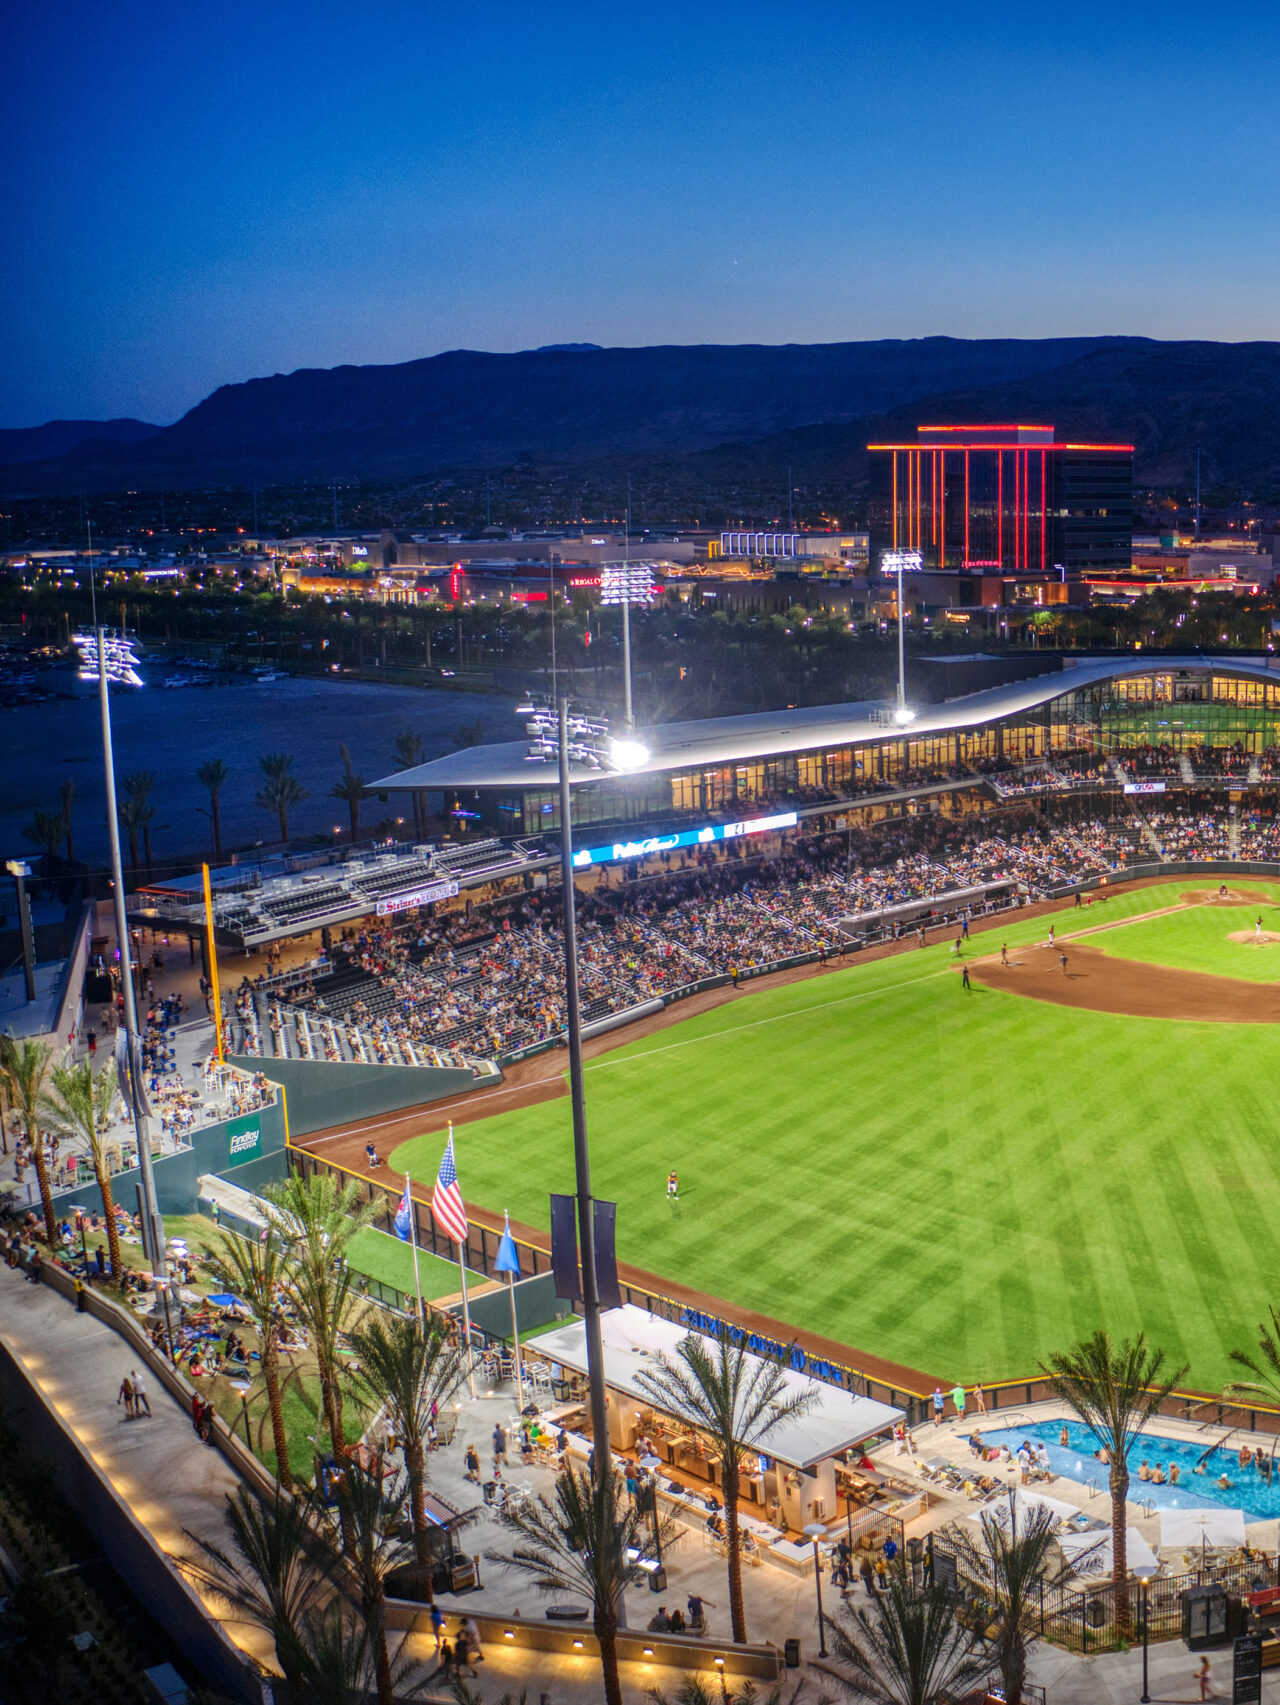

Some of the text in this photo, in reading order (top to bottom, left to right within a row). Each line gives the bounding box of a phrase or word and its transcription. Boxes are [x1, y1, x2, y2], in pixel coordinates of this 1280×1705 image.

[386, 896, 421, 912] Steiner's
[231, 1129, 260, 1147] Findlay
[230, 1141, 257, 1155] TOYOTA
